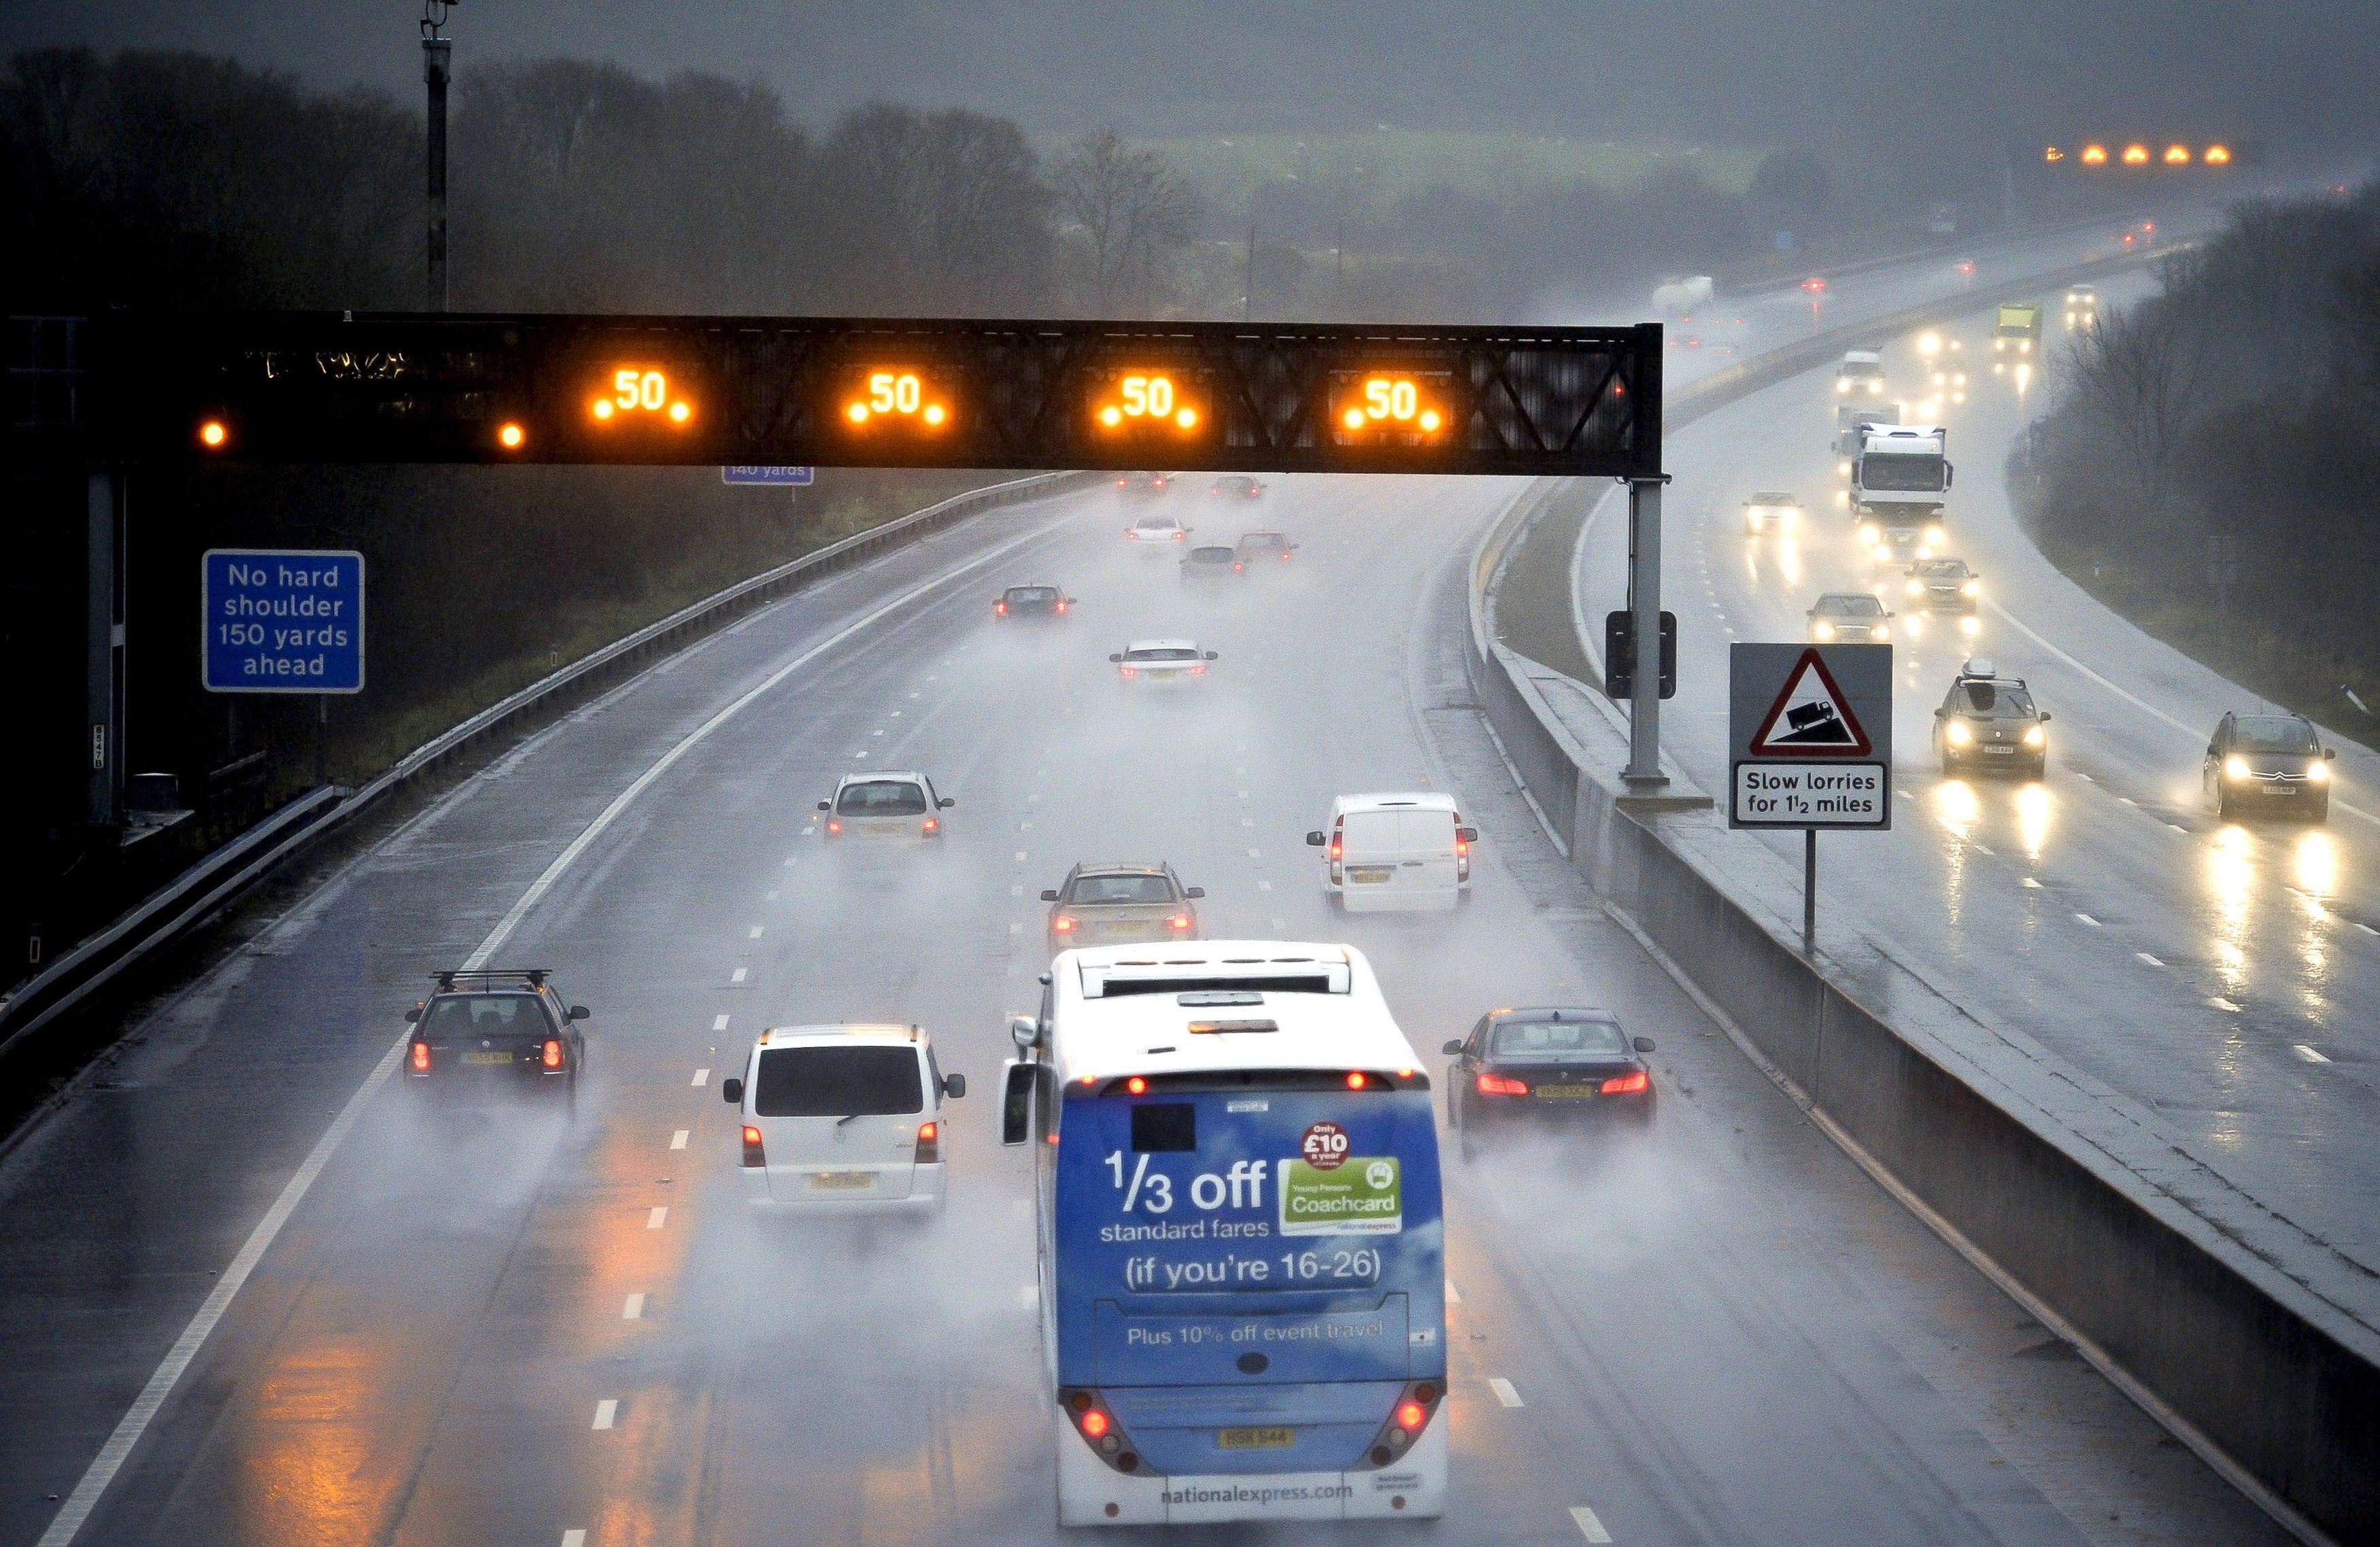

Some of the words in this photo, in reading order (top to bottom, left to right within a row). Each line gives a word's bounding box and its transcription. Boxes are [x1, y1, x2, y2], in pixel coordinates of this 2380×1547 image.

[615, 370, 666, 411] 50
[870, 373, 920, 413] 50
[1123, 376, 1173, 418] 50
[1365, 379, 1417, 420] 50
[228, 564, 267, 587] No
[279, 564, 339, 588] hard
[224, 594, 343, 616] shoulder
[219, 623, 265, 645] 150
[274, 624, 348, 650] yards
[243, 653, 324, 675] ahead
[1746, 771, 1799, 790] Slow
[1807, 772, 1876, 790] lorries
[1748, 794, 1778, 812] for
[1816, 795, 1873, 813] miles
[1313, 1124, 1336, 1134] Only
[1304, 1134, 1348, 1153] £10
[1319, 1153, 1341, 1161] year
[1191, 1159, 1268, 1210] off
[1292, 1195, 1395, 1213] Coachcard
[1100, 1220, 1205, 1242] standard
[1212, 1219, 1270, 1238] fares
[1126, 1256, 1156, 1290] (if
[1165, 1254, 1269, 1289] you're
[1281, 1248, 1382, 1283] 16-26)
[1127, 1327, 1172, 1345] Plus
[1180, 1326, 1223, 1344] 10%
[1231, 1324, 1259, 1342] off
[1263, 1322, 1320, 1341] event
[1327, 1320, 1383, 1338] travel
[1161, 1484, 1353, 1506] nationalexpress.com
